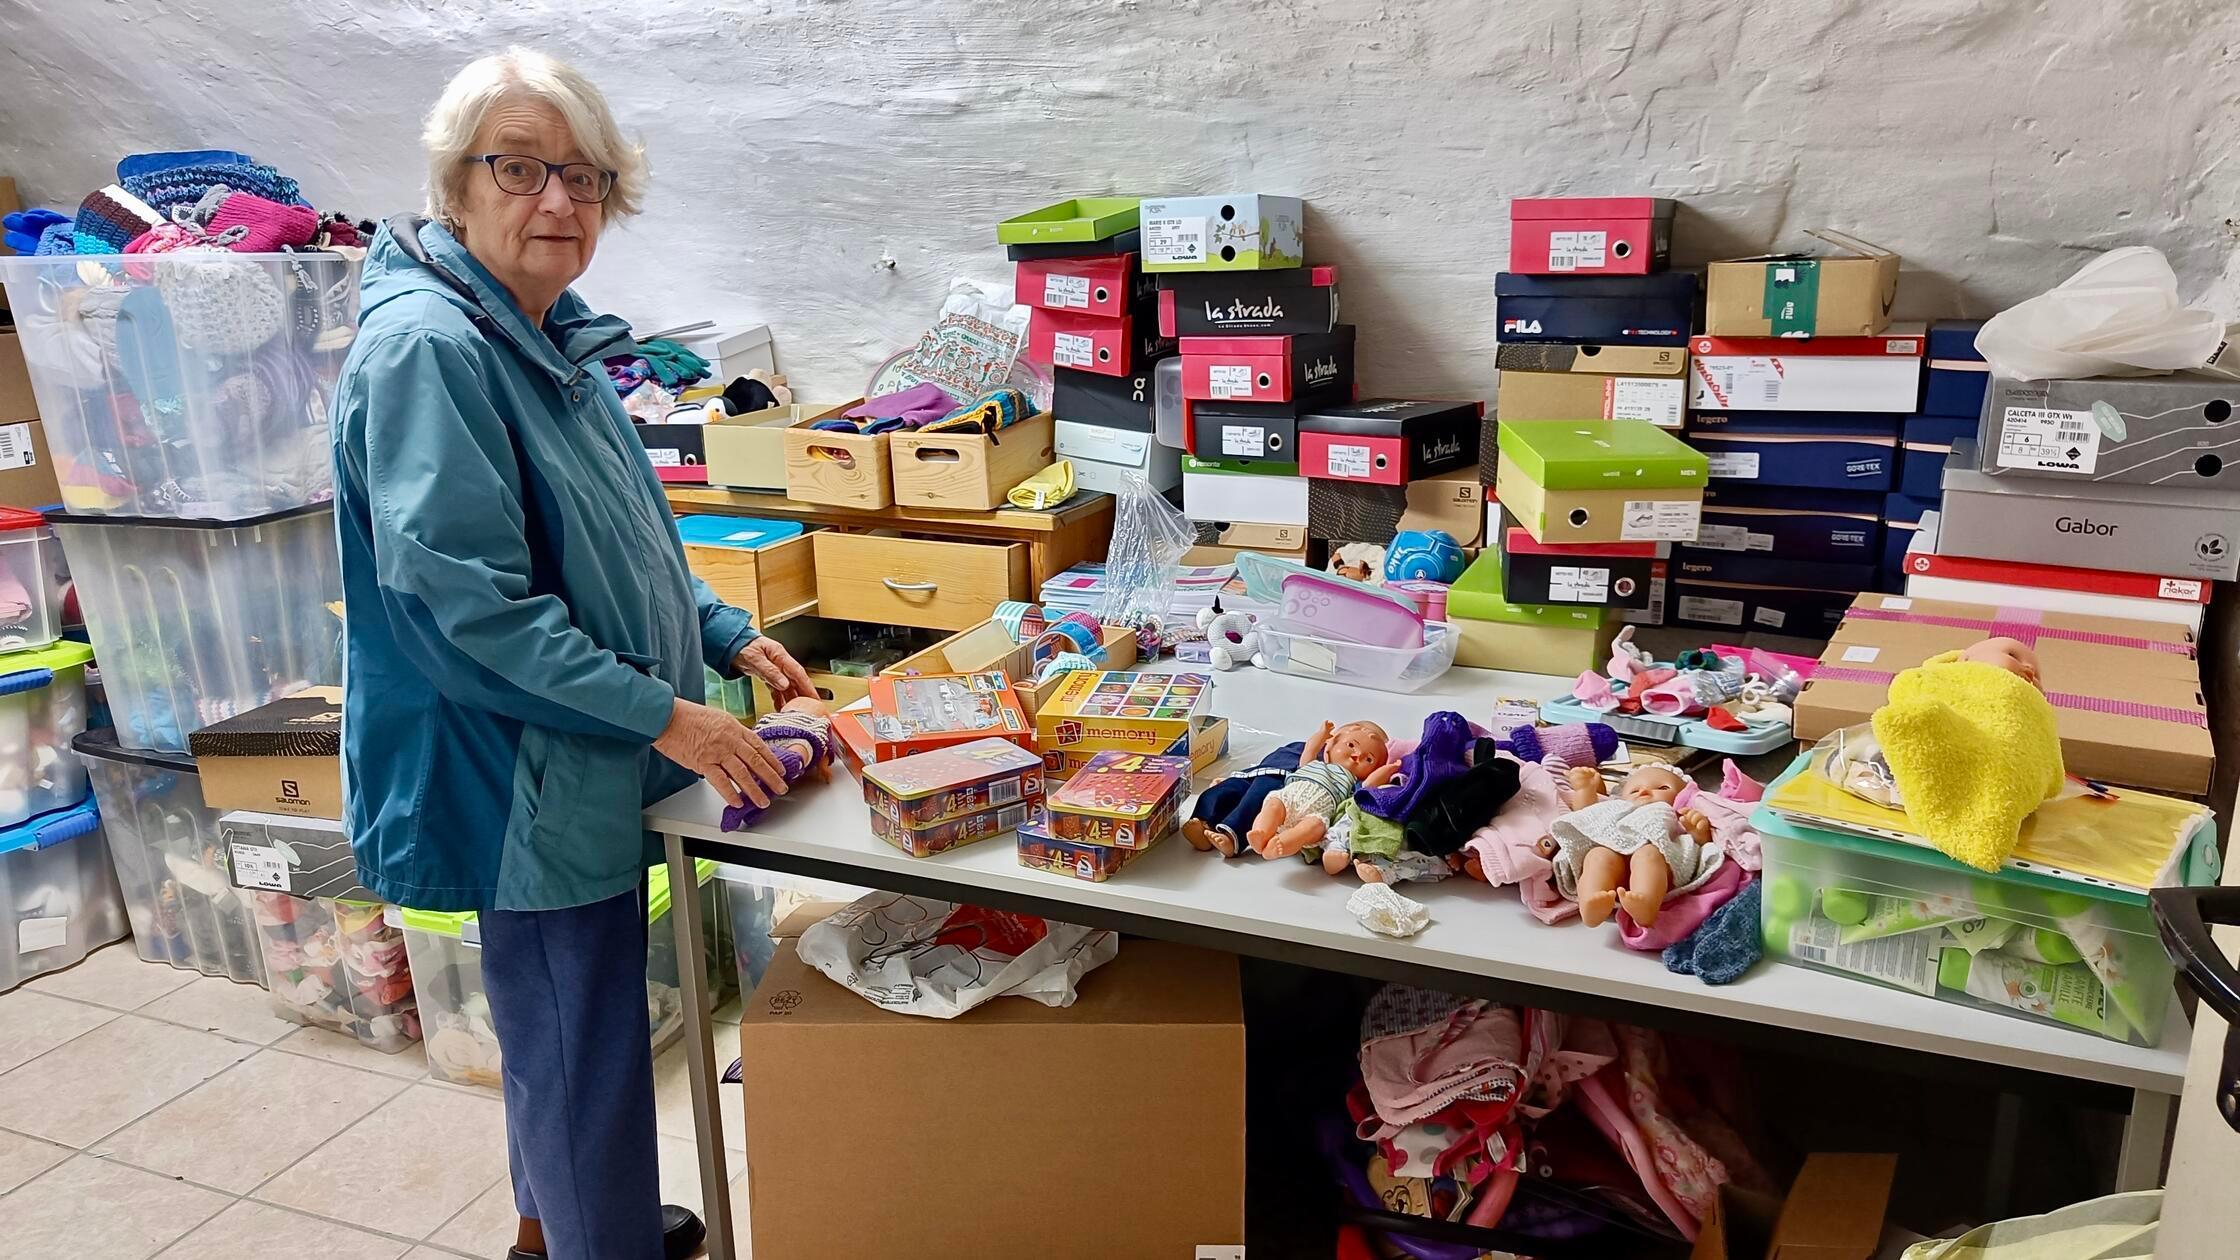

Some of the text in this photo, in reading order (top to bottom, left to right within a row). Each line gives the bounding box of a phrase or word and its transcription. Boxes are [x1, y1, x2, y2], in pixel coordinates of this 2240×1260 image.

[1205, 296, 1284, 321] la strada
[1504, 319, 1542, 334] FILA
[1304, 355, 1338, 382] la strada
[1697, 414, 1728, 425] legero
[2007, 410, 2036, 418] CALCETA
[1423, 434, 1460, 461] la strada
[2038, 461, 2080, 469] LOWA
[2055, 516, 2119, 536] Gabor
[1387, 546, 1409, 574] JAKO
[1682, 562, 1713, 572] legero
[1060, 672, 1098, 703] memory
[1087, 726, 1158, 746] memory
[1111, 755, 1146, 773] 4
[275, 797, 311, 806] salomon
